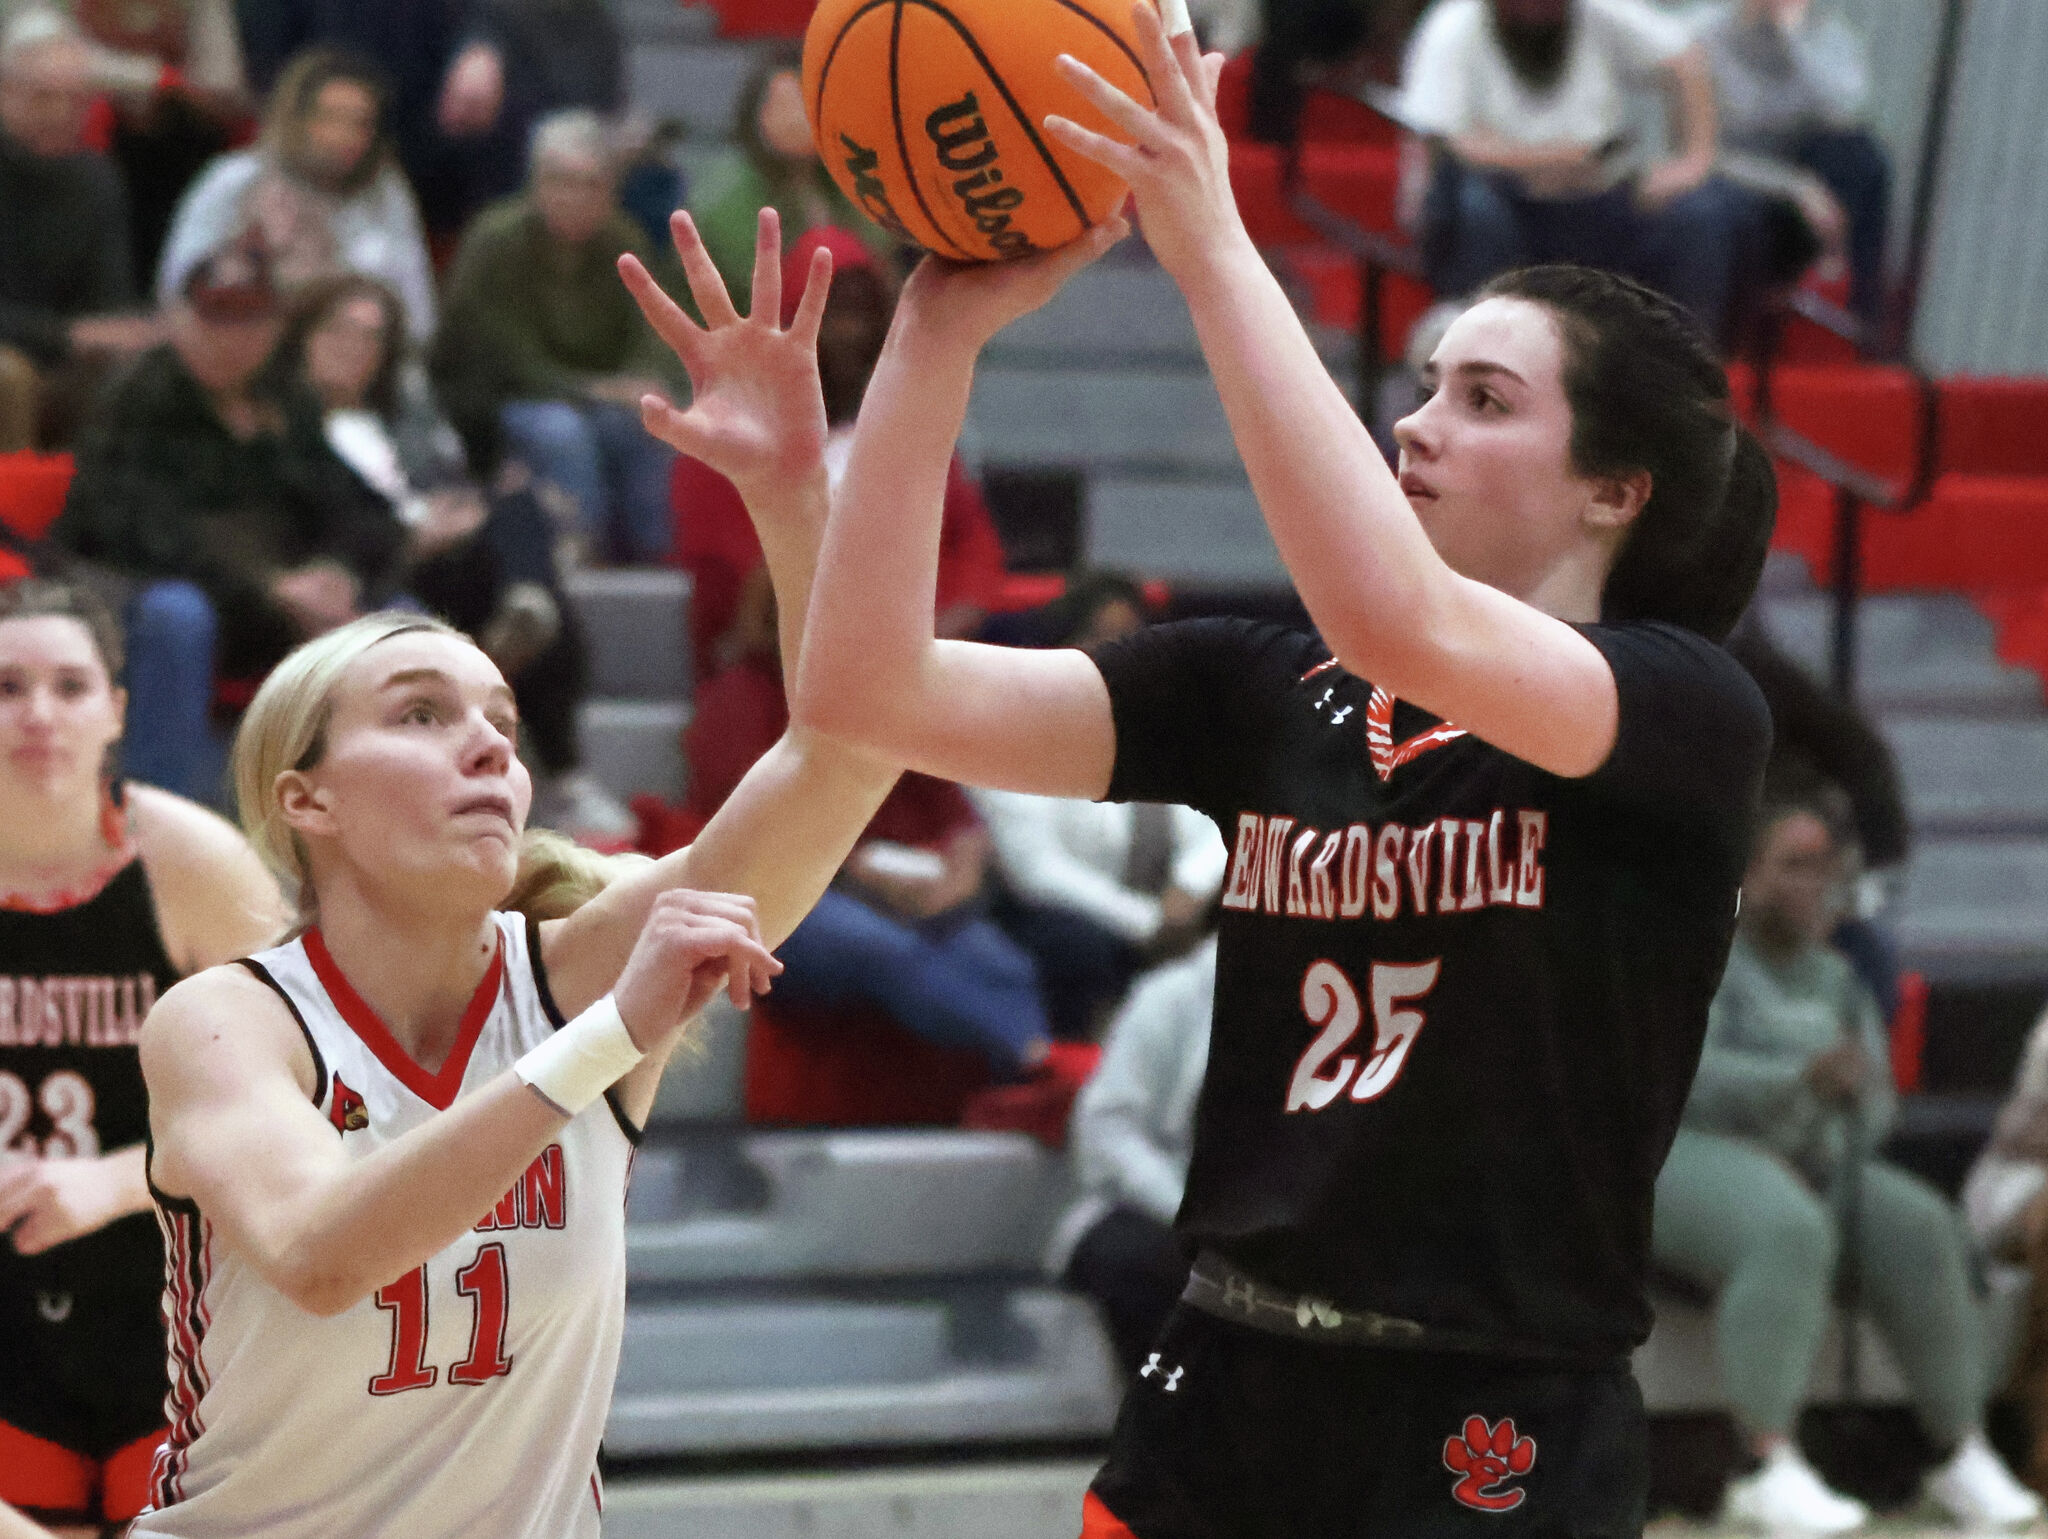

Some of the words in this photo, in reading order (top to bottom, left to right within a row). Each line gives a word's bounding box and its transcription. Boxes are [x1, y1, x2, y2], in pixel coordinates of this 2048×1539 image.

[925, 90, 1036, 258] Wilso
[1222, 810, 1548, 920] EDWARDSVILLE
[1284, 957, 1442, 1114] 25
[368, 1242, 513, 1396] 11
